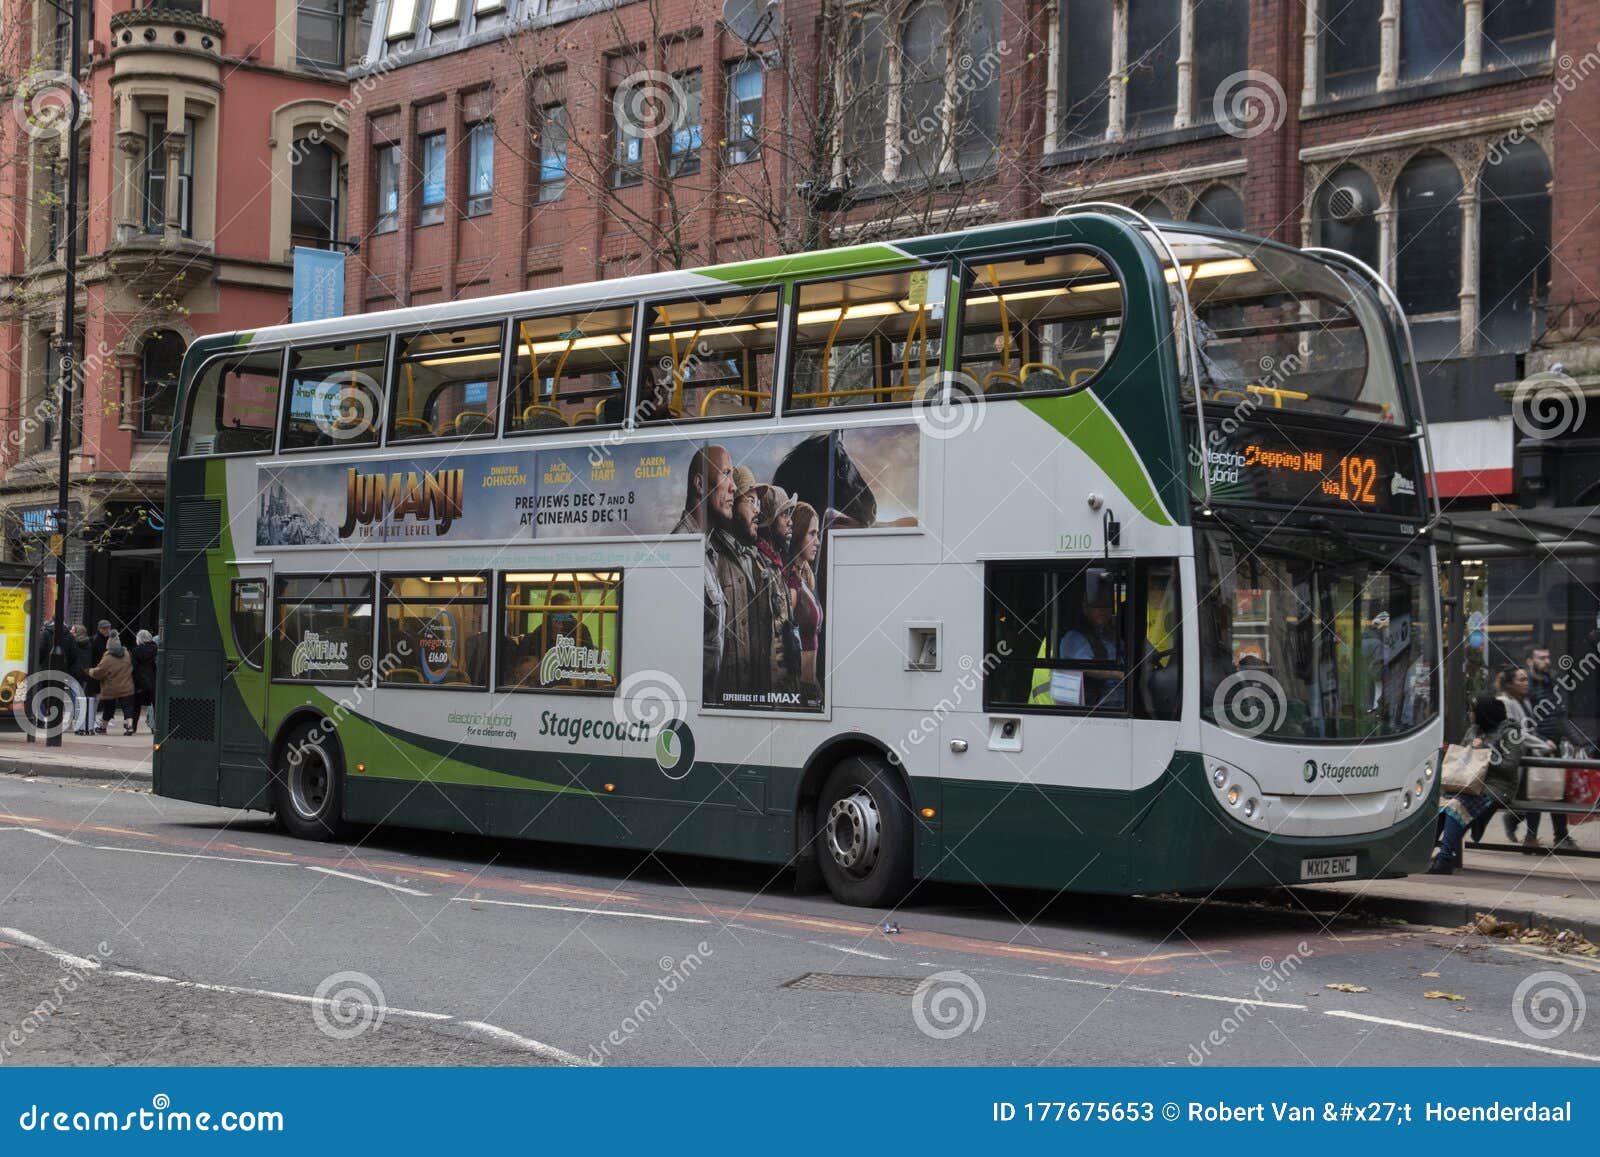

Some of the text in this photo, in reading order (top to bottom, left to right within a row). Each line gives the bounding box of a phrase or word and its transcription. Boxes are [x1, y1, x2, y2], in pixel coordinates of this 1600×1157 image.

[639, 456, 666, 466] KAREN
[1245, 445, 1323, 471] Stepping Hill
[550, 463, 567, 472] JACK
[591, 468, 616, 481] HART
[634, 465, 671, 479] GILLAN
[481, 474, 527, 488] JOHNSON
[543, 472, 572, 484] BLACK
[1339, 456, 1377, 503] 192
[1321, 480, 1340, 496] via
[339, 467, 464, 538] JUMANJI
[515, 490, 635, 509] PREVIEWS DEC 7 AND 8
[519, 508, 628, 526] AT CINEMAS DEC 11
[359, 524, 431, 537] THE NEXT LEVEL
[1060, 534, 1092, 550] 12110
[722, 693, 752, 702] EXPERIENCE
[753, 694, 758, 702] IT
[767, 692, 801, 704] IMAX
[505, 729, 517, 740] city
[538, 710, 649, 745] Stagecoach
[1320, 762, 1379, 783] Stagecoach
[1307, 859, 1351, 876] MX12 ENC
